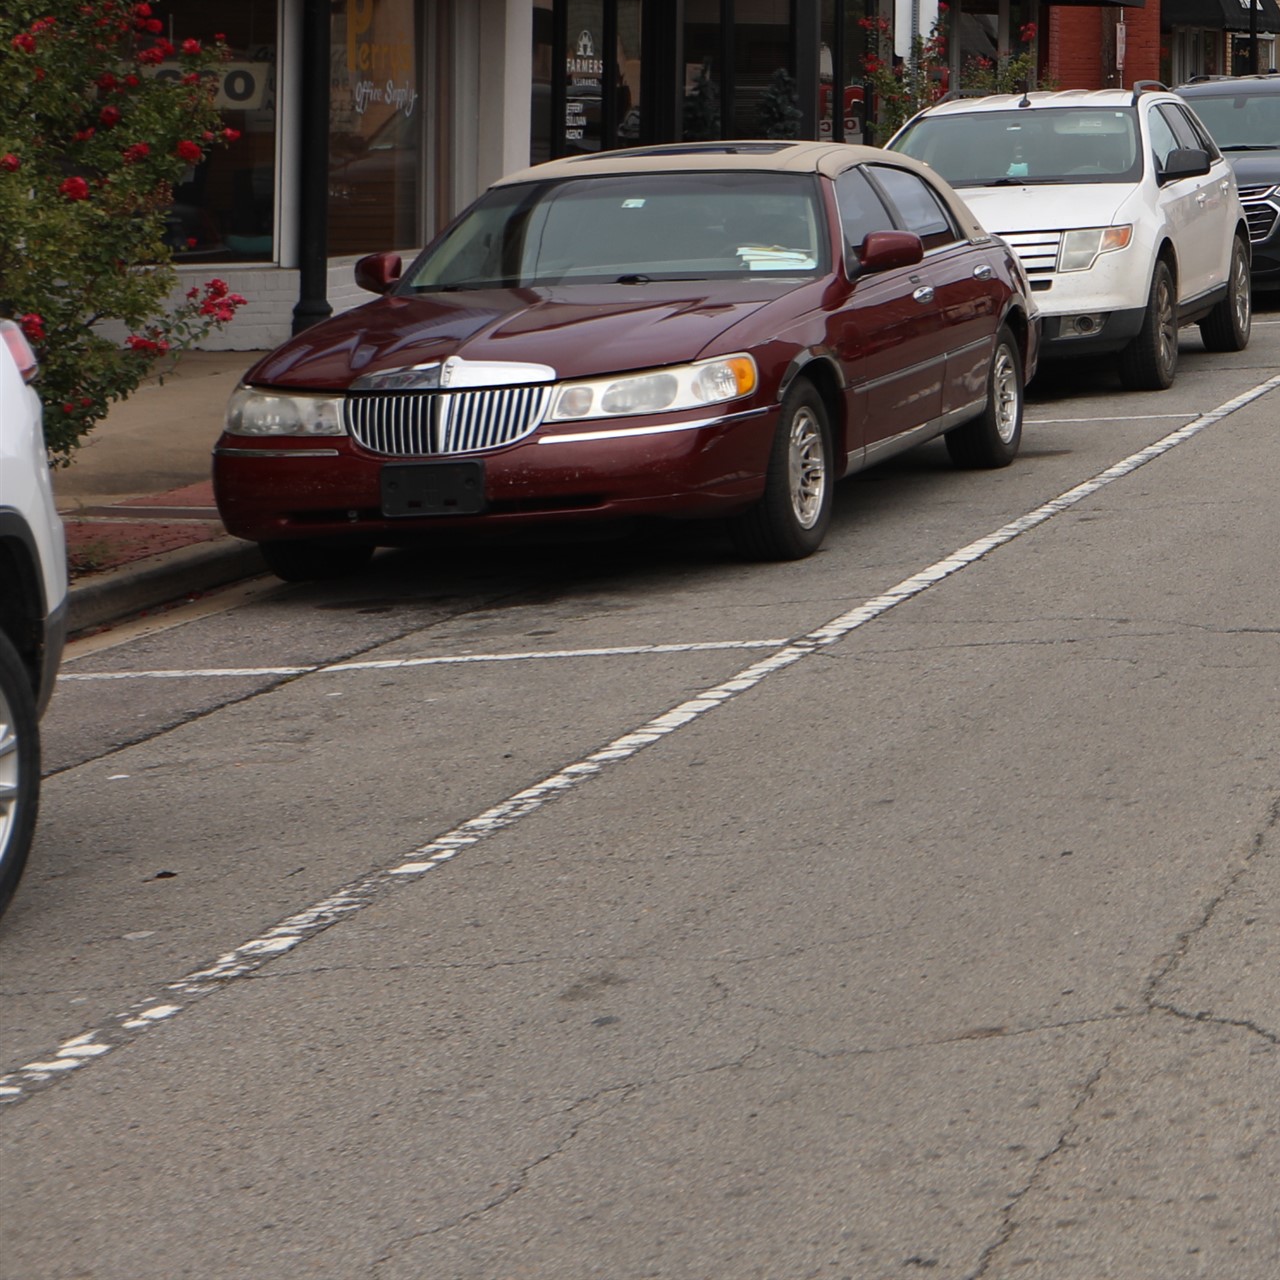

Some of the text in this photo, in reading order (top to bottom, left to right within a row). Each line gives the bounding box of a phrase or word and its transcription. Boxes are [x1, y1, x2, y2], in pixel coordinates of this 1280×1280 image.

[565, 59, 603, 74] FARMERS
[355, 80, 383, 114] Office
[385, 80, 418, 117] Supply
[565, 128, 584, 139] AGENCY
